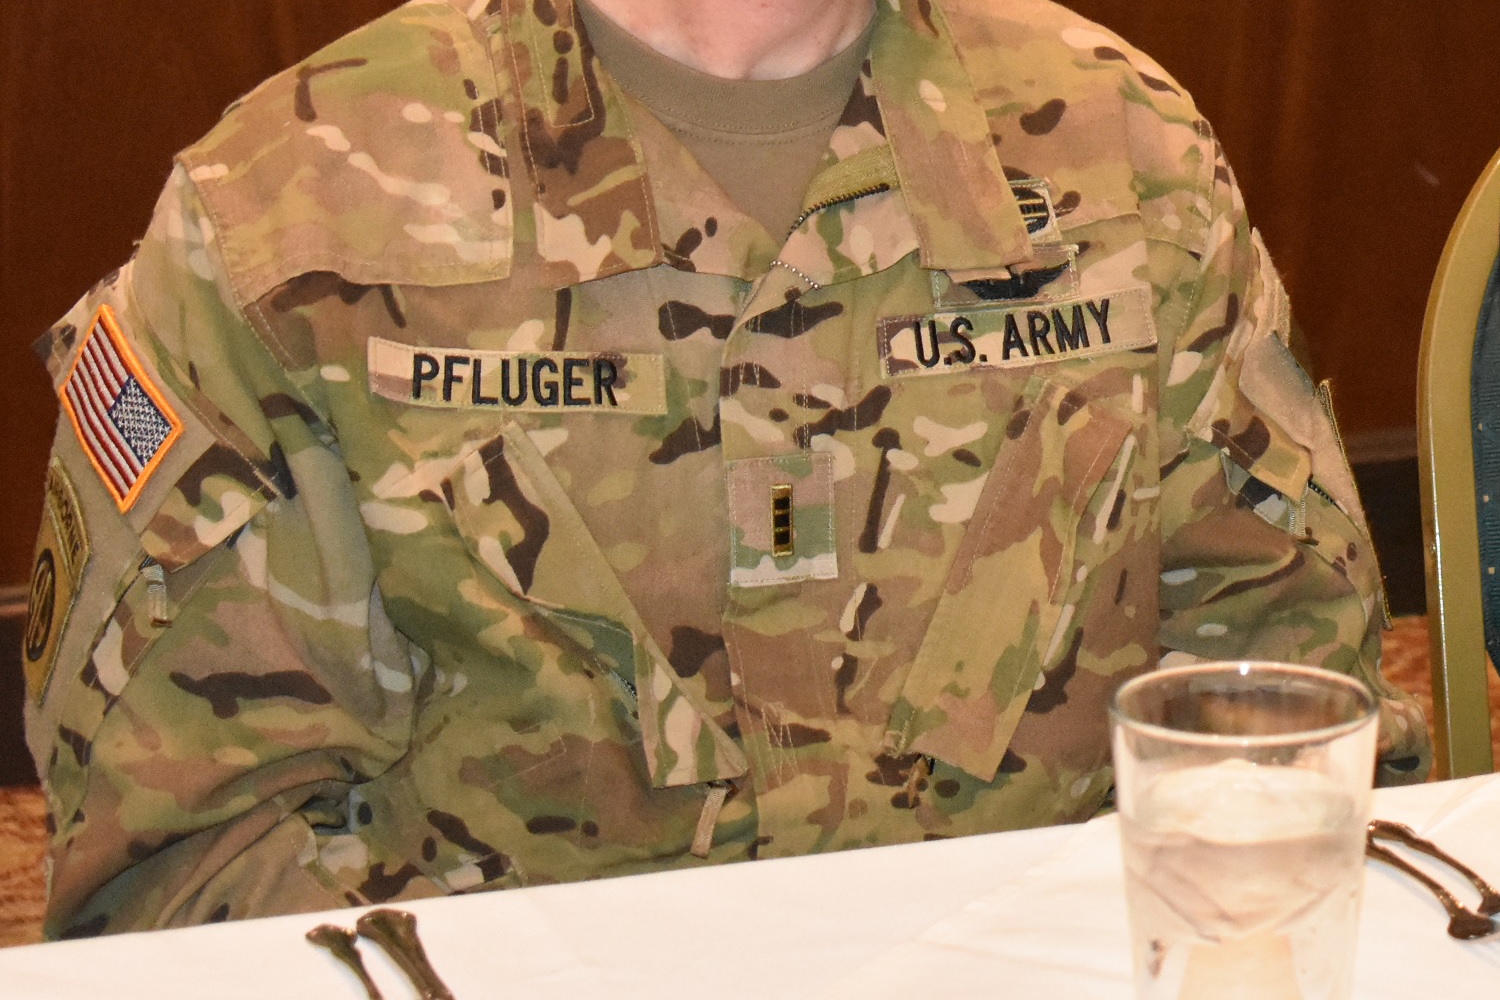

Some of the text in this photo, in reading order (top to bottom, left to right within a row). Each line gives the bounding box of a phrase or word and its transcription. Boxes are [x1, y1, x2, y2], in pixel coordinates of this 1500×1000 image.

[913, 298, 1112, 368] U.S. ARMY
[411, 352, 619, 407] PFLUGER
